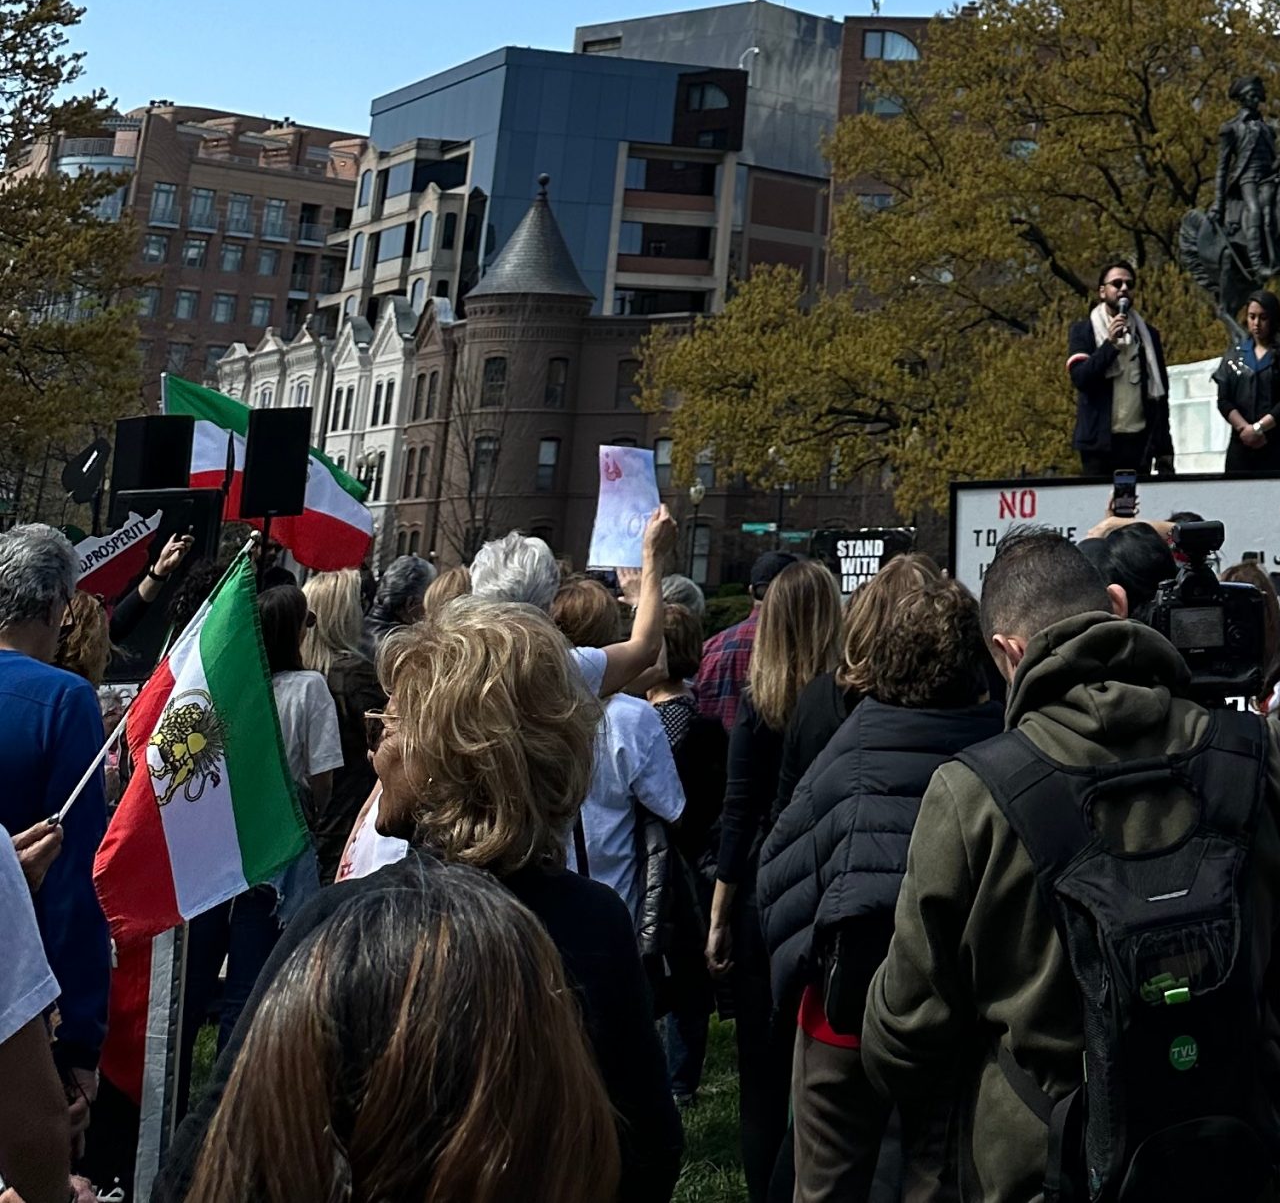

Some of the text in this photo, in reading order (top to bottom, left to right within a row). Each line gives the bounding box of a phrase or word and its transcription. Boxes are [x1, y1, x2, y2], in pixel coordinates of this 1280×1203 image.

[998, 489, 1037, 519] NO
[973, 529, 997, 547] TO
[836, 540, 884, 557] STAND
[840, 557, 880, 574] WITH
[1172, 1044, 1197, 1059] TVU
